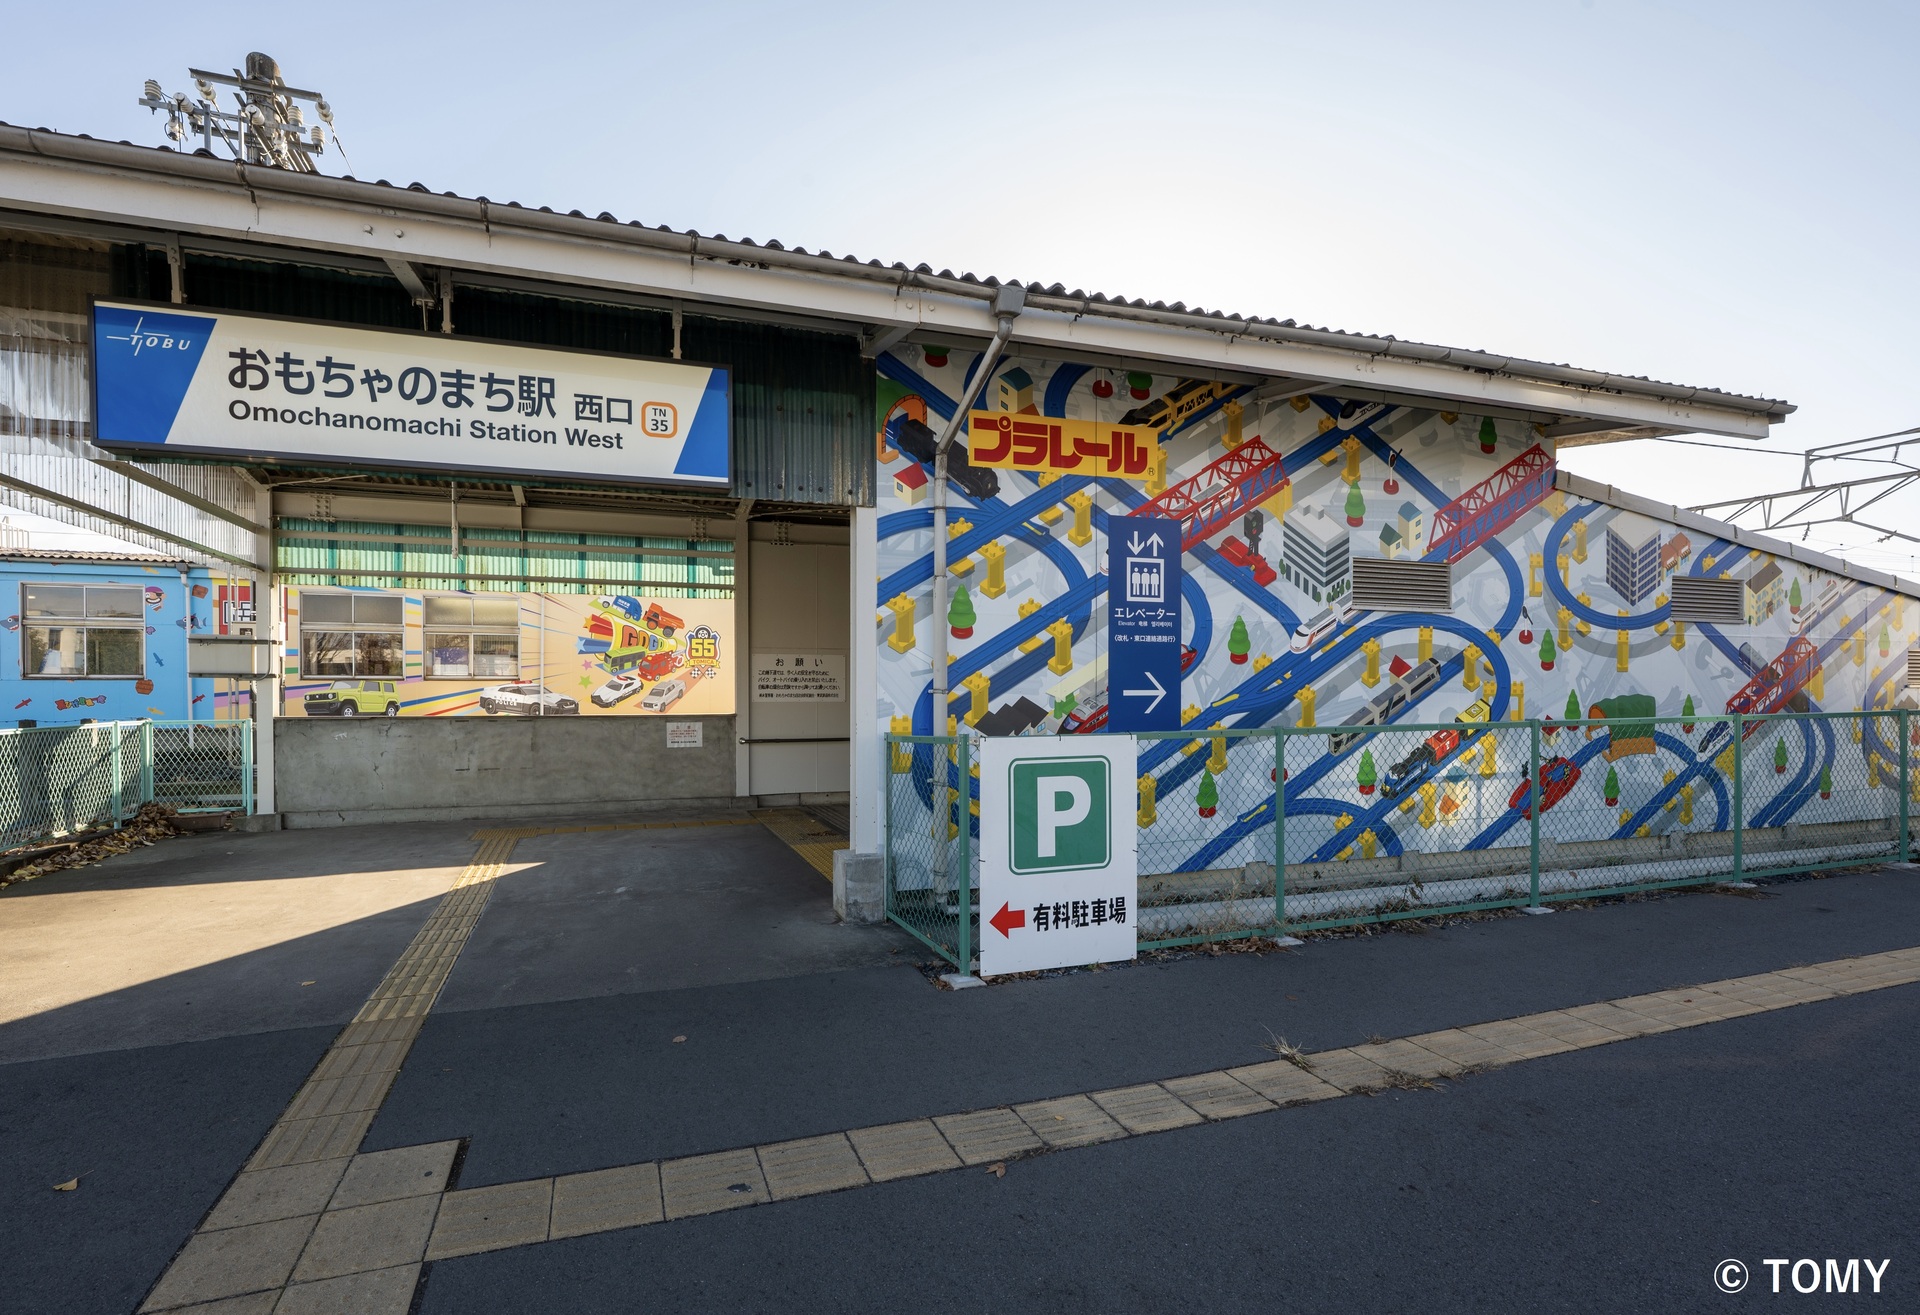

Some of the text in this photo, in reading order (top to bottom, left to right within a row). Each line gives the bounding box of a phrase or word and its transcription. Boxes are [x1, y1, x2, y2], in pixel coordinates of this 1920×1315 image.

[130, 334, 191, 350] TOBU
[228, 347, 633, 425] おもちゃのまち駅 西口
[228, 399, 624, 450] Omochanomachi Station West
[650, 419, 669, 432] 35
[651, 407, 668, 418] TN
[973, 415, 1148, 475] プラレール
[1114, 607, 1176, 620] エレベーター
[691, 638, 715, 657] 55
[1036, 775, 1092, 858] P
[1033, 896, 1127, 932] 有料駐車場
